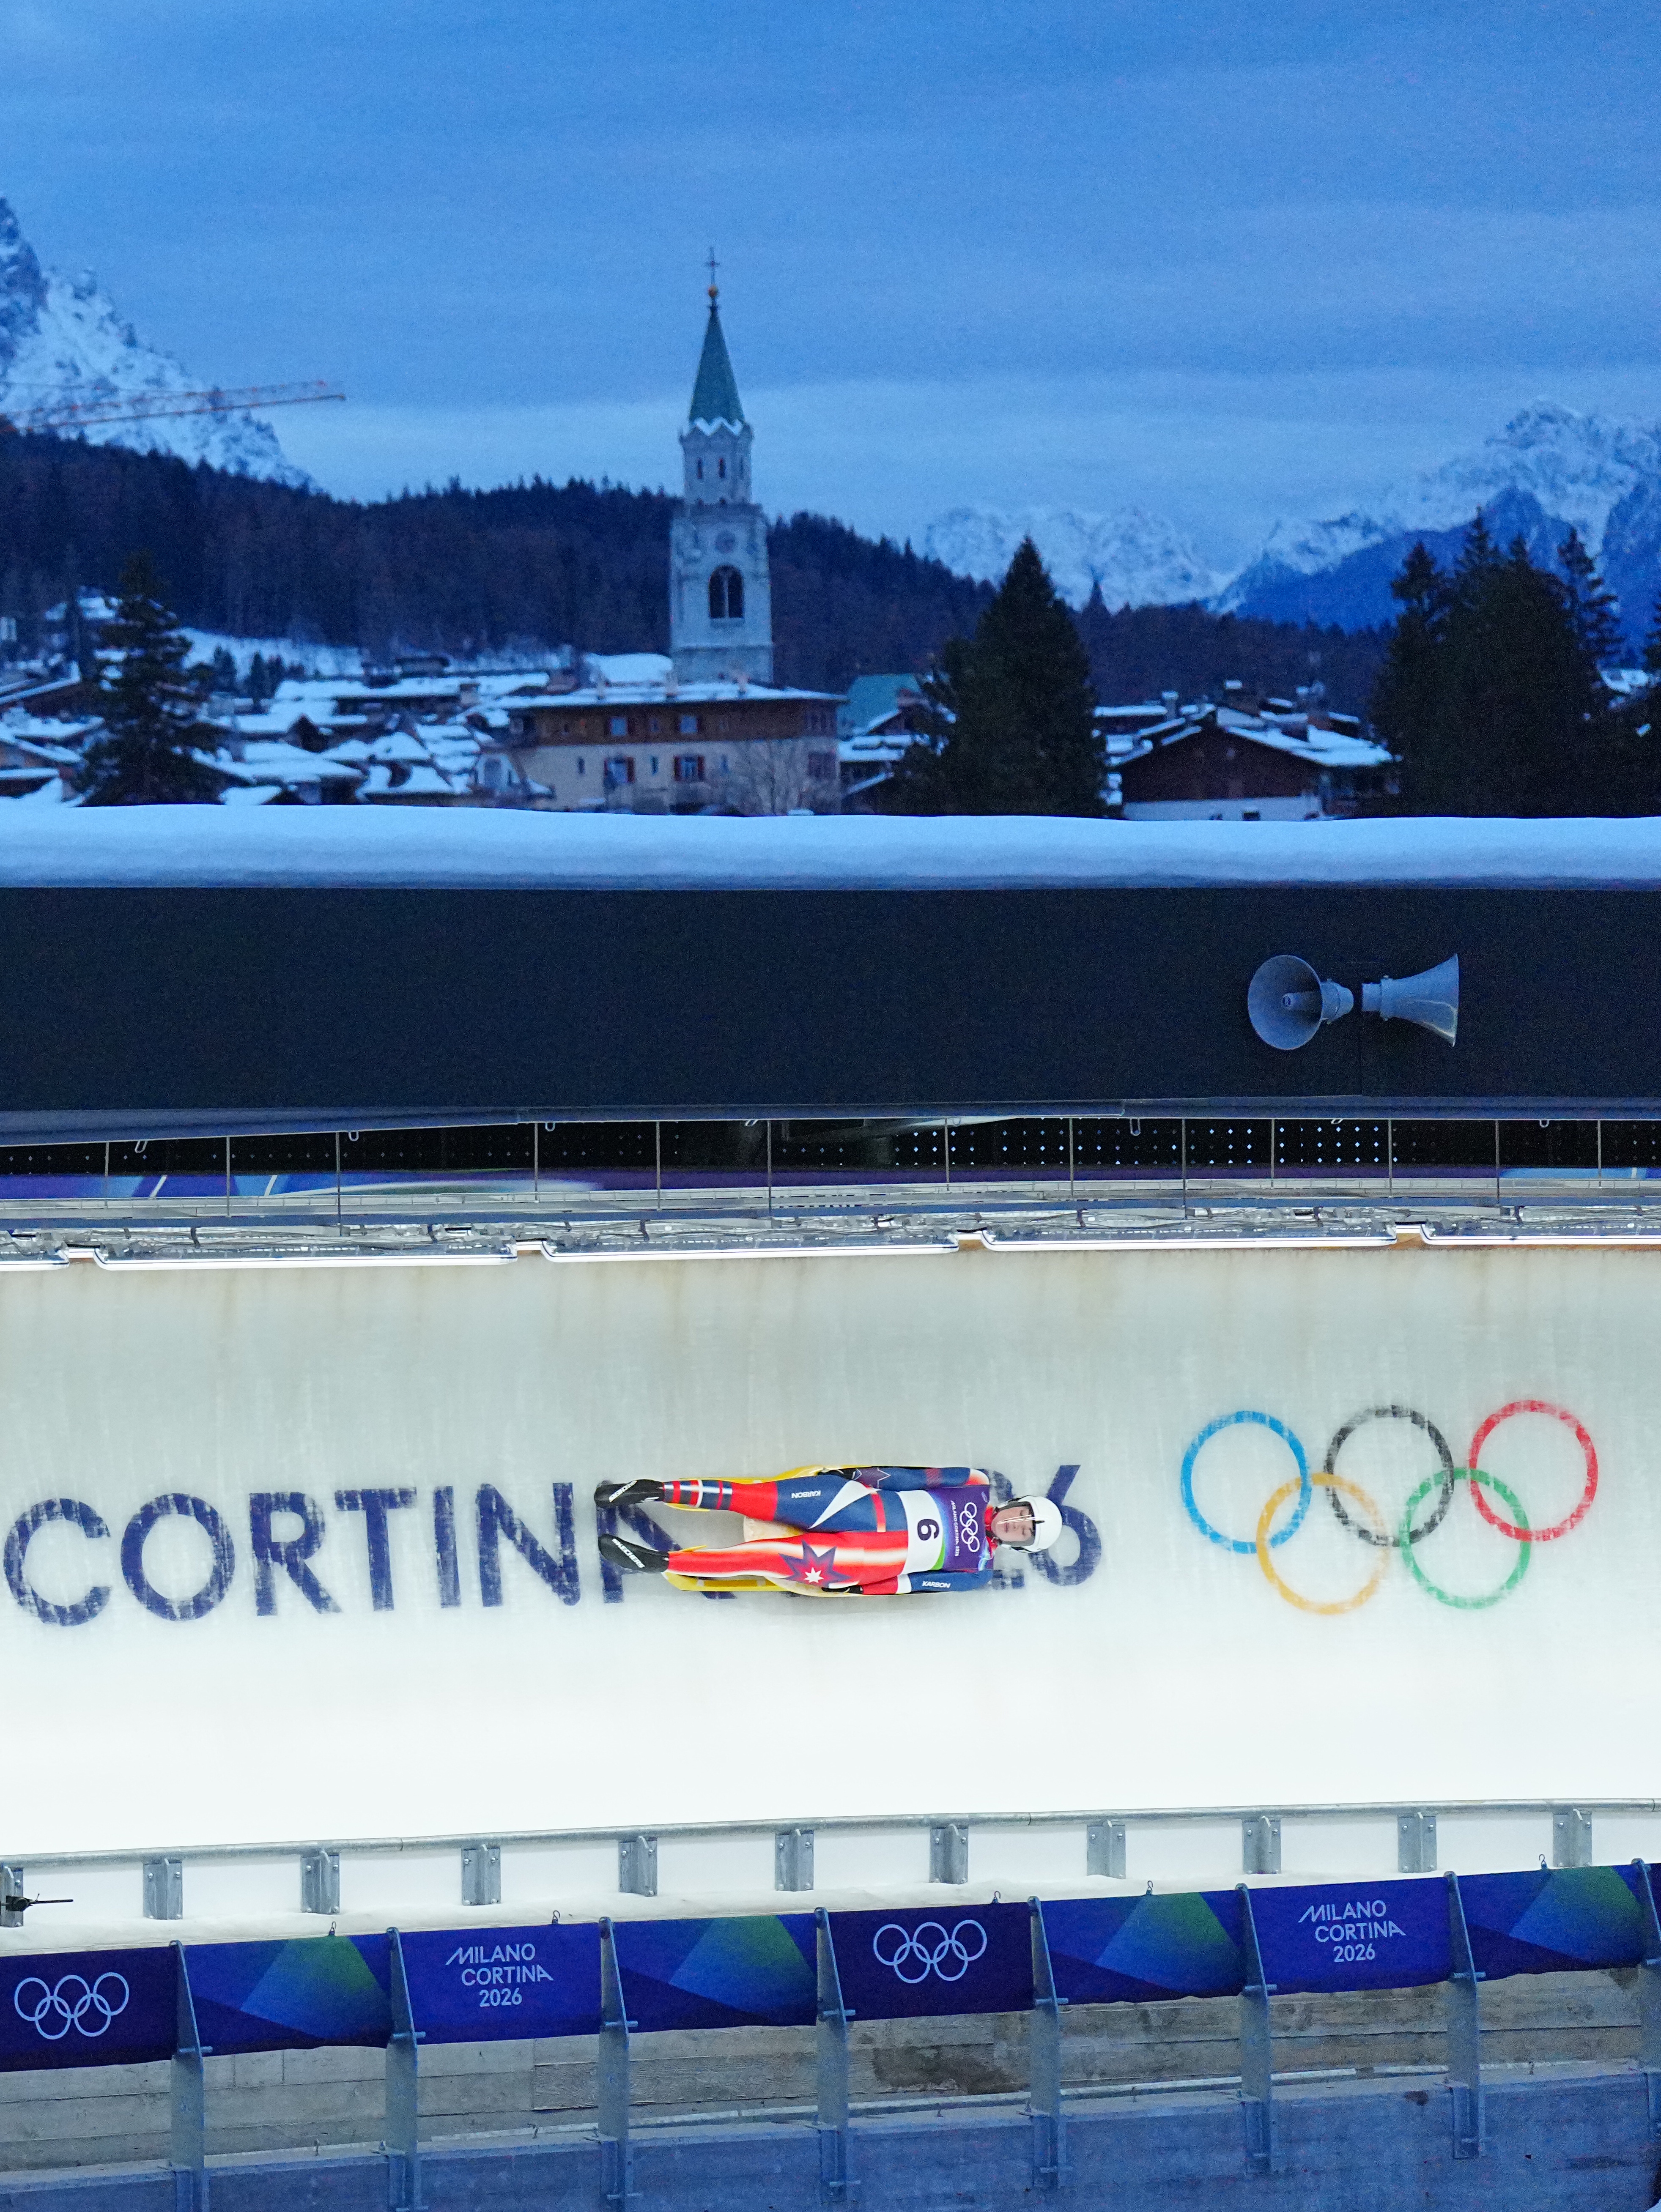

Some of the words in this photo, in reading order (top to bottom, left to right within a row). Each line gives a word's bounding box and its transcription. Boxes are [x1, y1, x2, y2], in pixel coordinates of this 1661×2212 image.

[791, 1490, 821, 1499] KARBON
[917, 1519, 940, 1541] 6
[612, 1538, 645, 1568] SKECHERS
[1298, 1900, 1387, 1923] MILANO
[1315, 1920, 1407, 1942] CORTINA
[445, 1943, 536, 1965] MILANO
[1333, 1943, 1376, 1963] 2026
[461, 1964, 554, 1986] CORTINA
[479, 1988, 522, 2007] 2026
